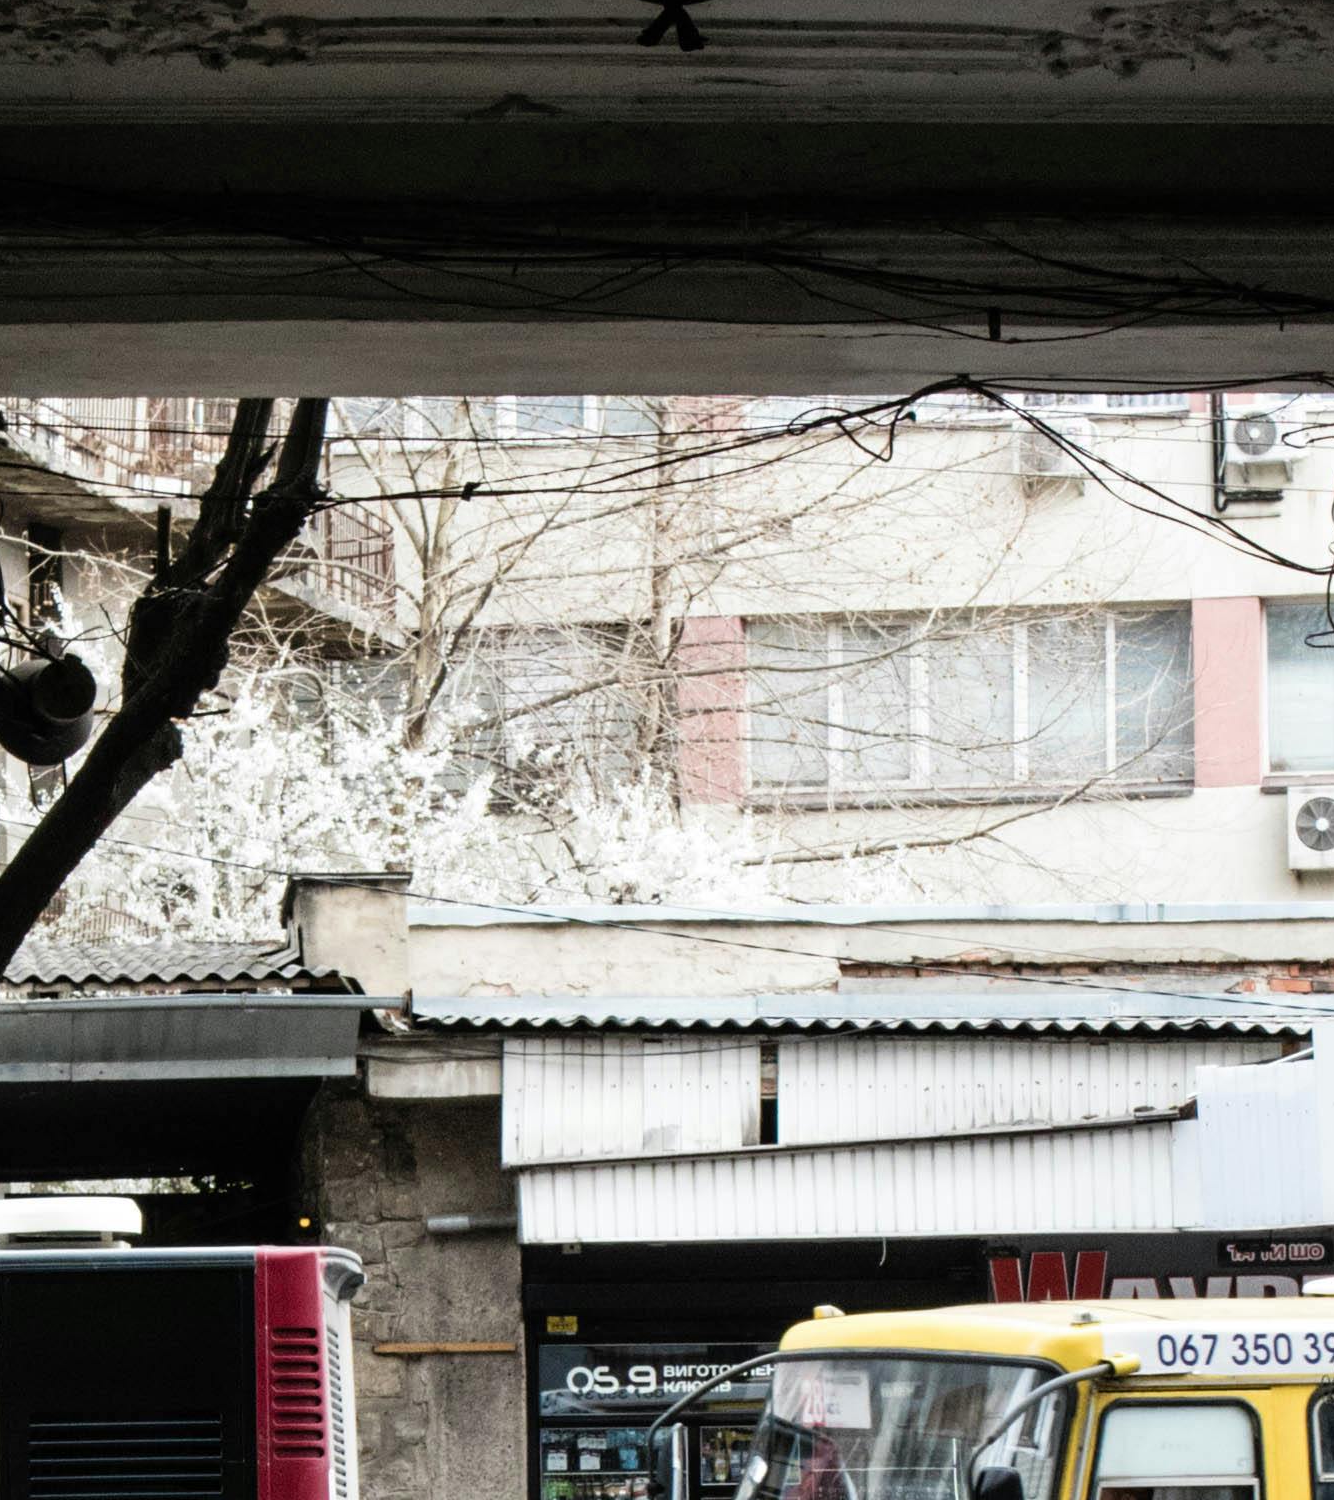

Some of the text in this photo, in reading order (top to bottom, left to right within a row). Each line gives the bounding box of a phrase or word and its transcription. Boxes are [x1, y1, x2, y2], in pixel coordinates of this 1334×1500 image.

[1289, 1243, 1325, 1261] ШО
[1157, 1333, 1218, 1366] 067
[1231, 1332, 1292, 1365] 350
